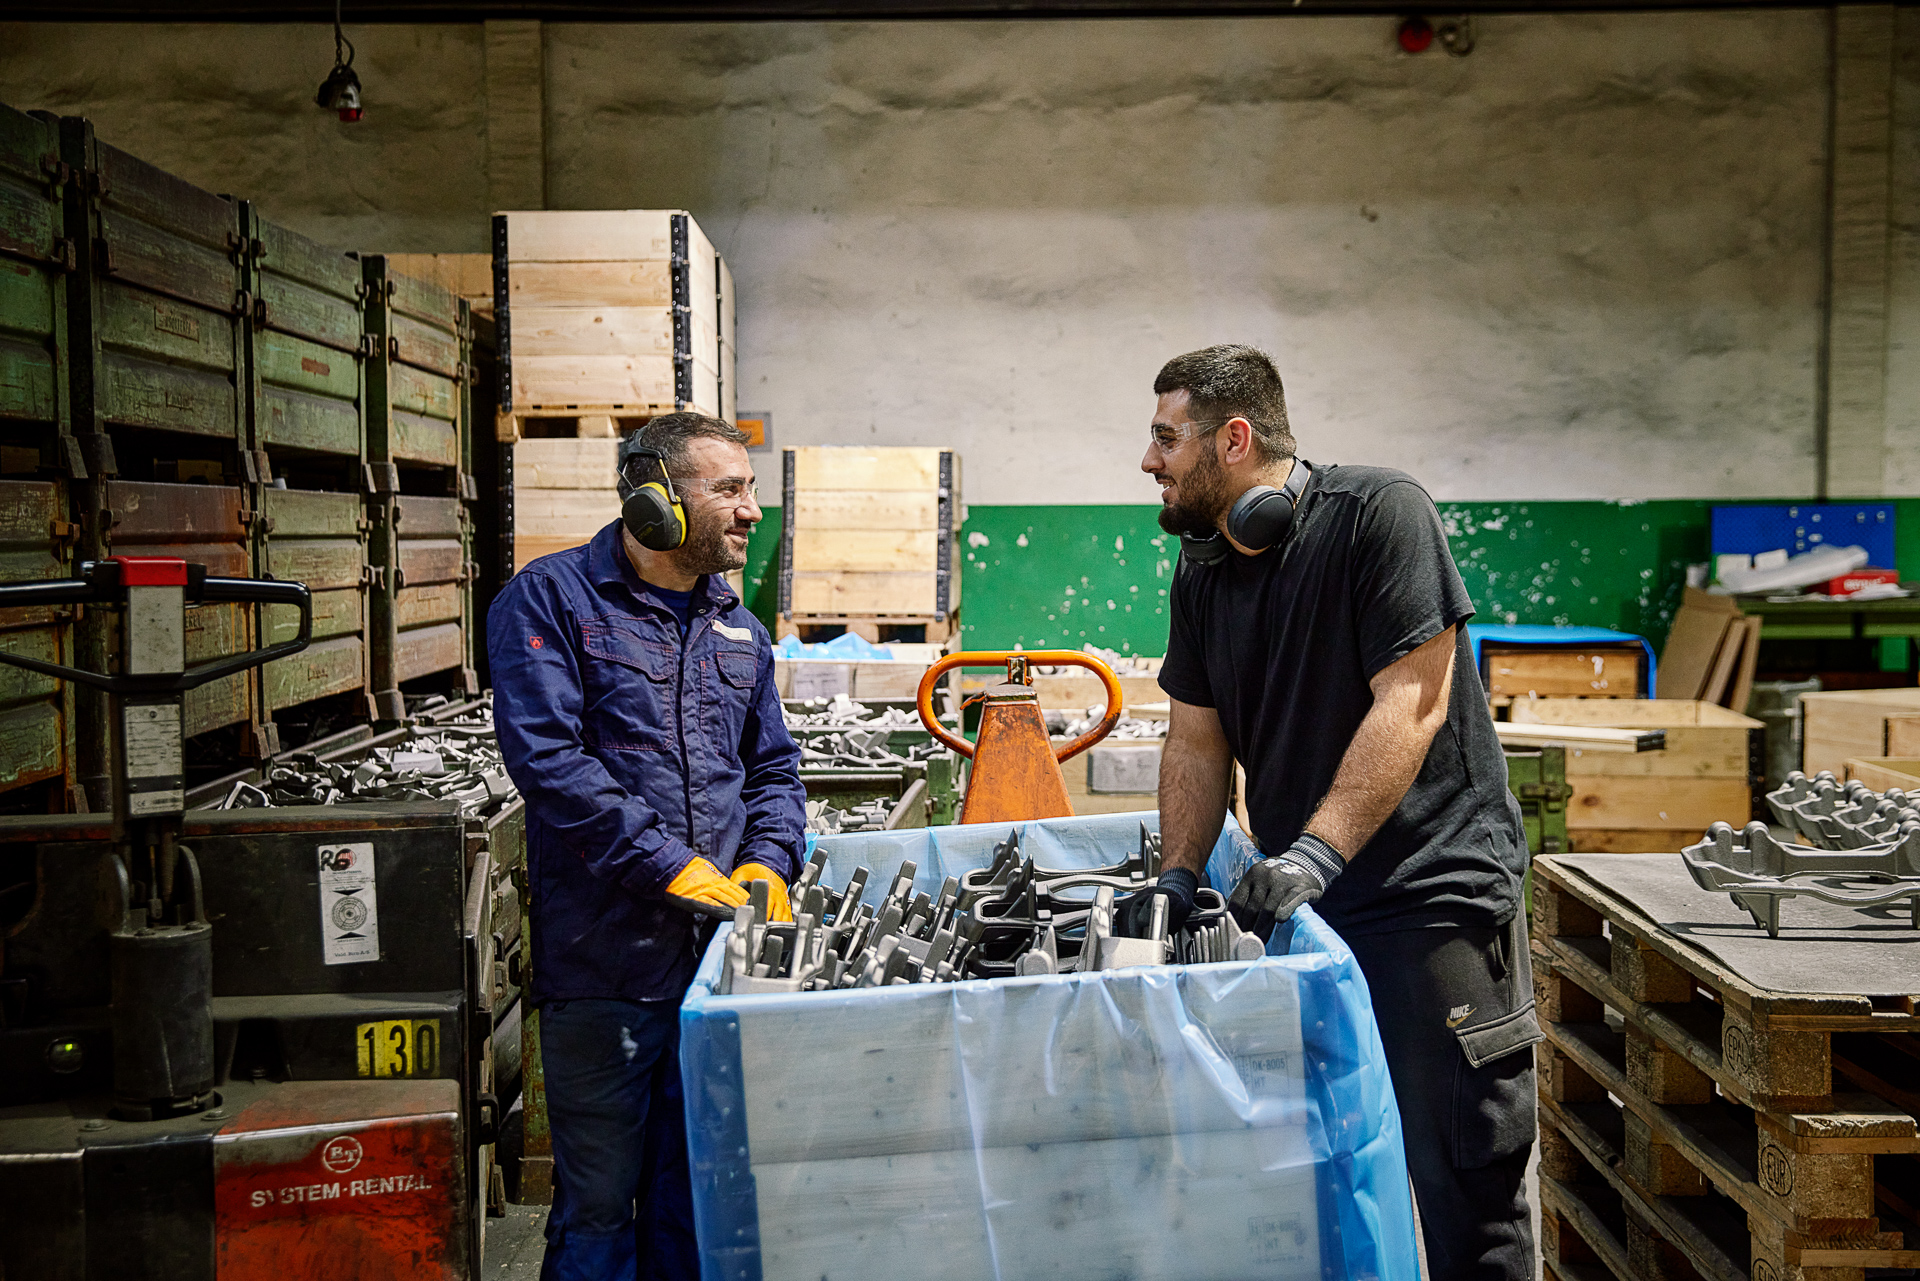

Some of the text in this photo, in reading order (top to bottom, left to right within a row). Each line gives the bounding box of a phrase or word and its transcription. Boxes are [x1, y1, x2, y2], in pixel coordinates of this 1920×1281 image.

[1450, 1003, 1470, 1019] NIKE
[364, 1024, 436, 1078] 130
[1728, 1033, 1747, 1068] EPAL
[330, 1146, 358, 1163] BT
[1767, 1152, 1786, 1190] EUR
